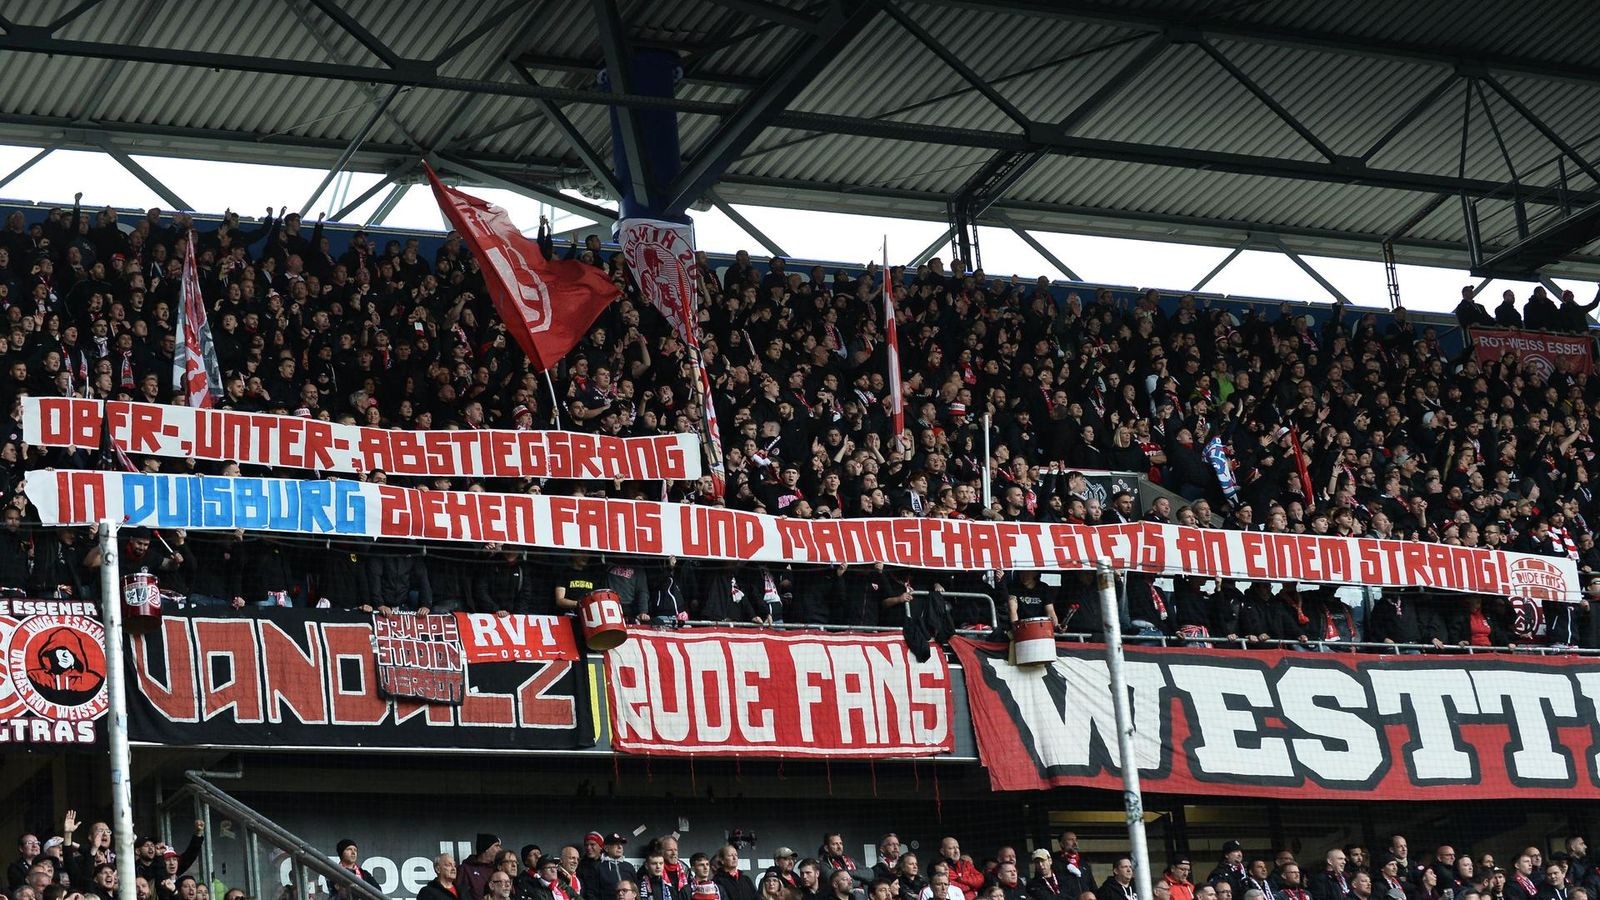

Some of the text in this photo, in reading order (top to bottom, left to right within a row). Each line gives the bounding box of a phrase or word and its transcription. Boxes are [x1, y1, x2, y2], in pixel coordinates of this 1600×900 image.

[1480, 336, 1587, 355] ROT-WEISS ESSEN
[56, 471, 1510, 595] IN DUISBURG ZIEHEN FANS UND MANNSCHAFT STETS AN EINEM STRANG!
[1516, 572, 1538, 584] RUDE
[12, 600, 97, 616] ESSENER
[373, 614, 459, 641] GRUPPE
[467, 612, 559, 646] RVT
[377, 638, 463, 671] STADION
[501, 649, 543, 658] 0221
[606, 637, 949, 746] RUDE FANS
[986, 656, 1600, 783] WESTT
